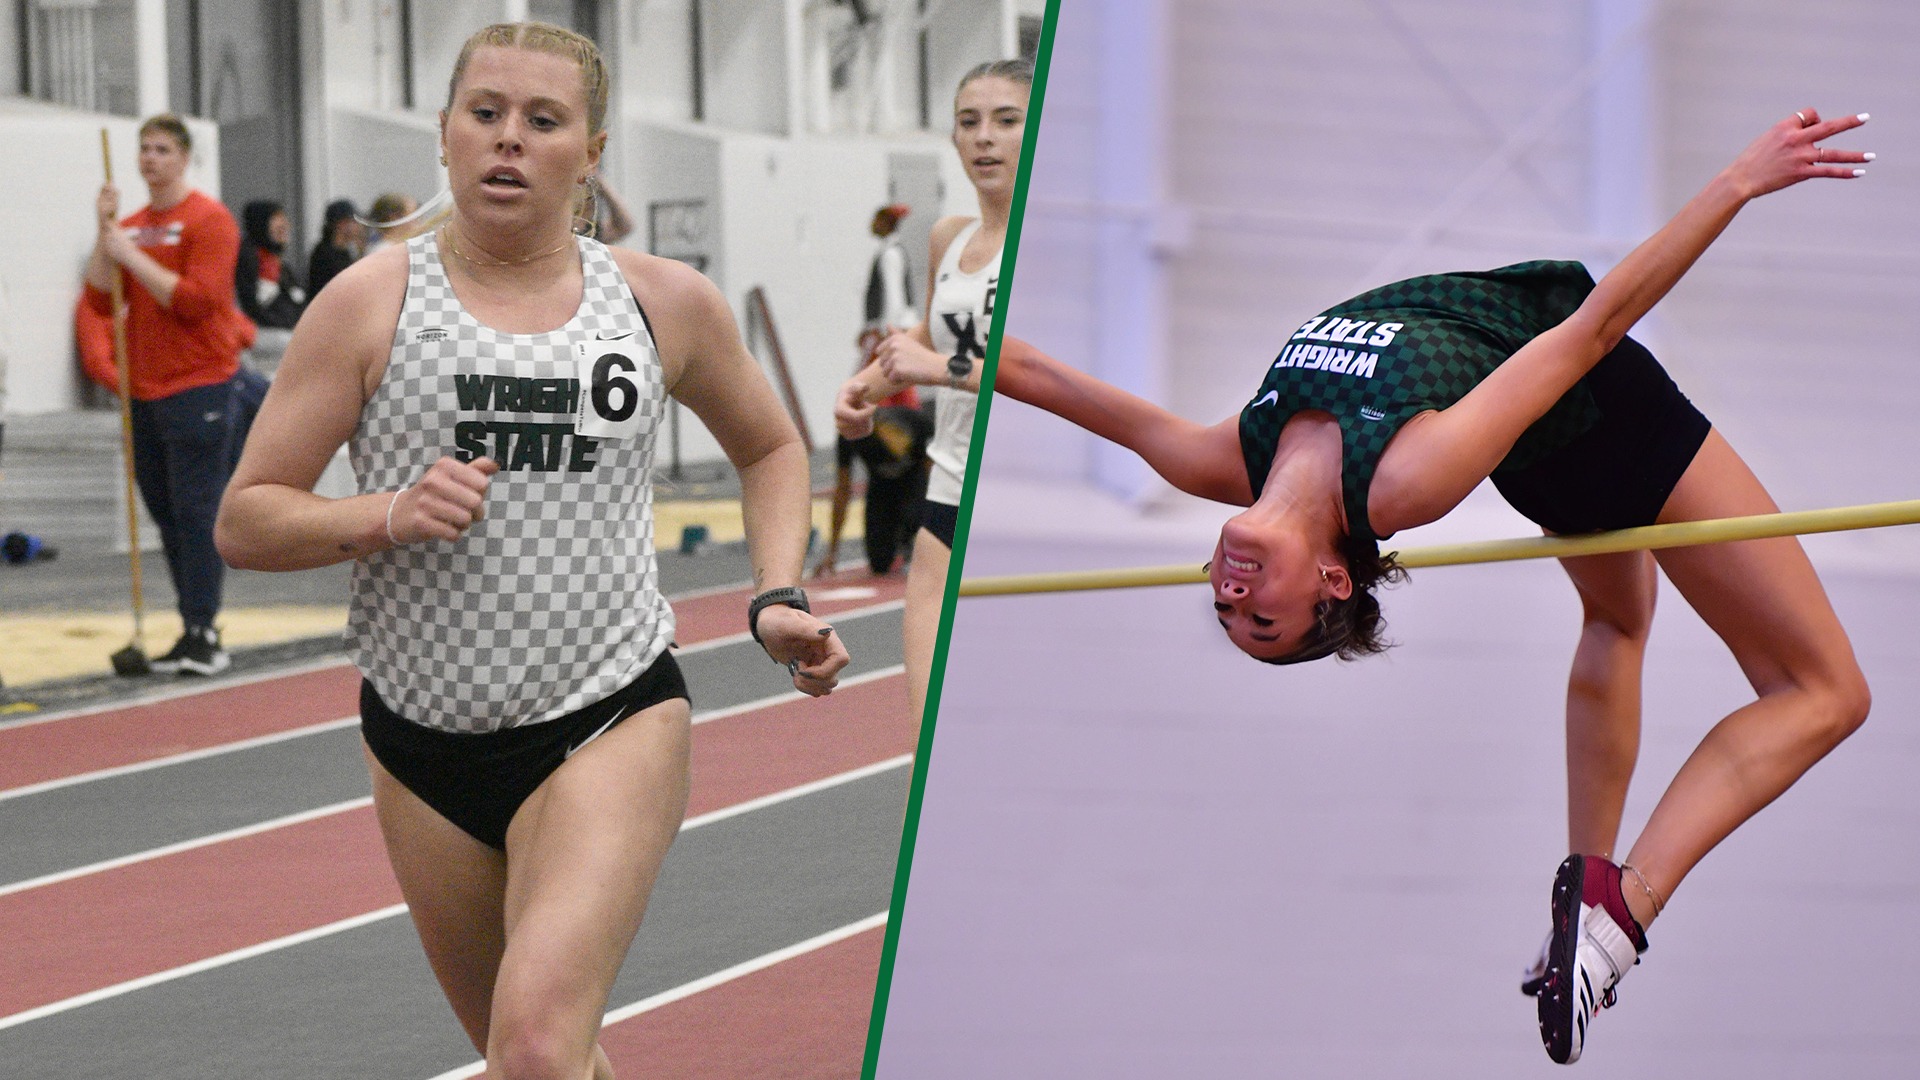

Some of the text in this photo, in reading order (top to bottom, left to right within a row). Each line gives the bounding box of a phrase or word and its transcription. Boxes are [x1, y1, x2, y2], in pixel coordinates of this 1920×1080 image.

[1292, 315, 1405, 347] STATE
[1274, 344, 1379, 379] WRIGHT
[454, 374, 580, 413] WRIGH
[591, 353, 638, 422] 6
[455, 421, 599, 472] STATE
